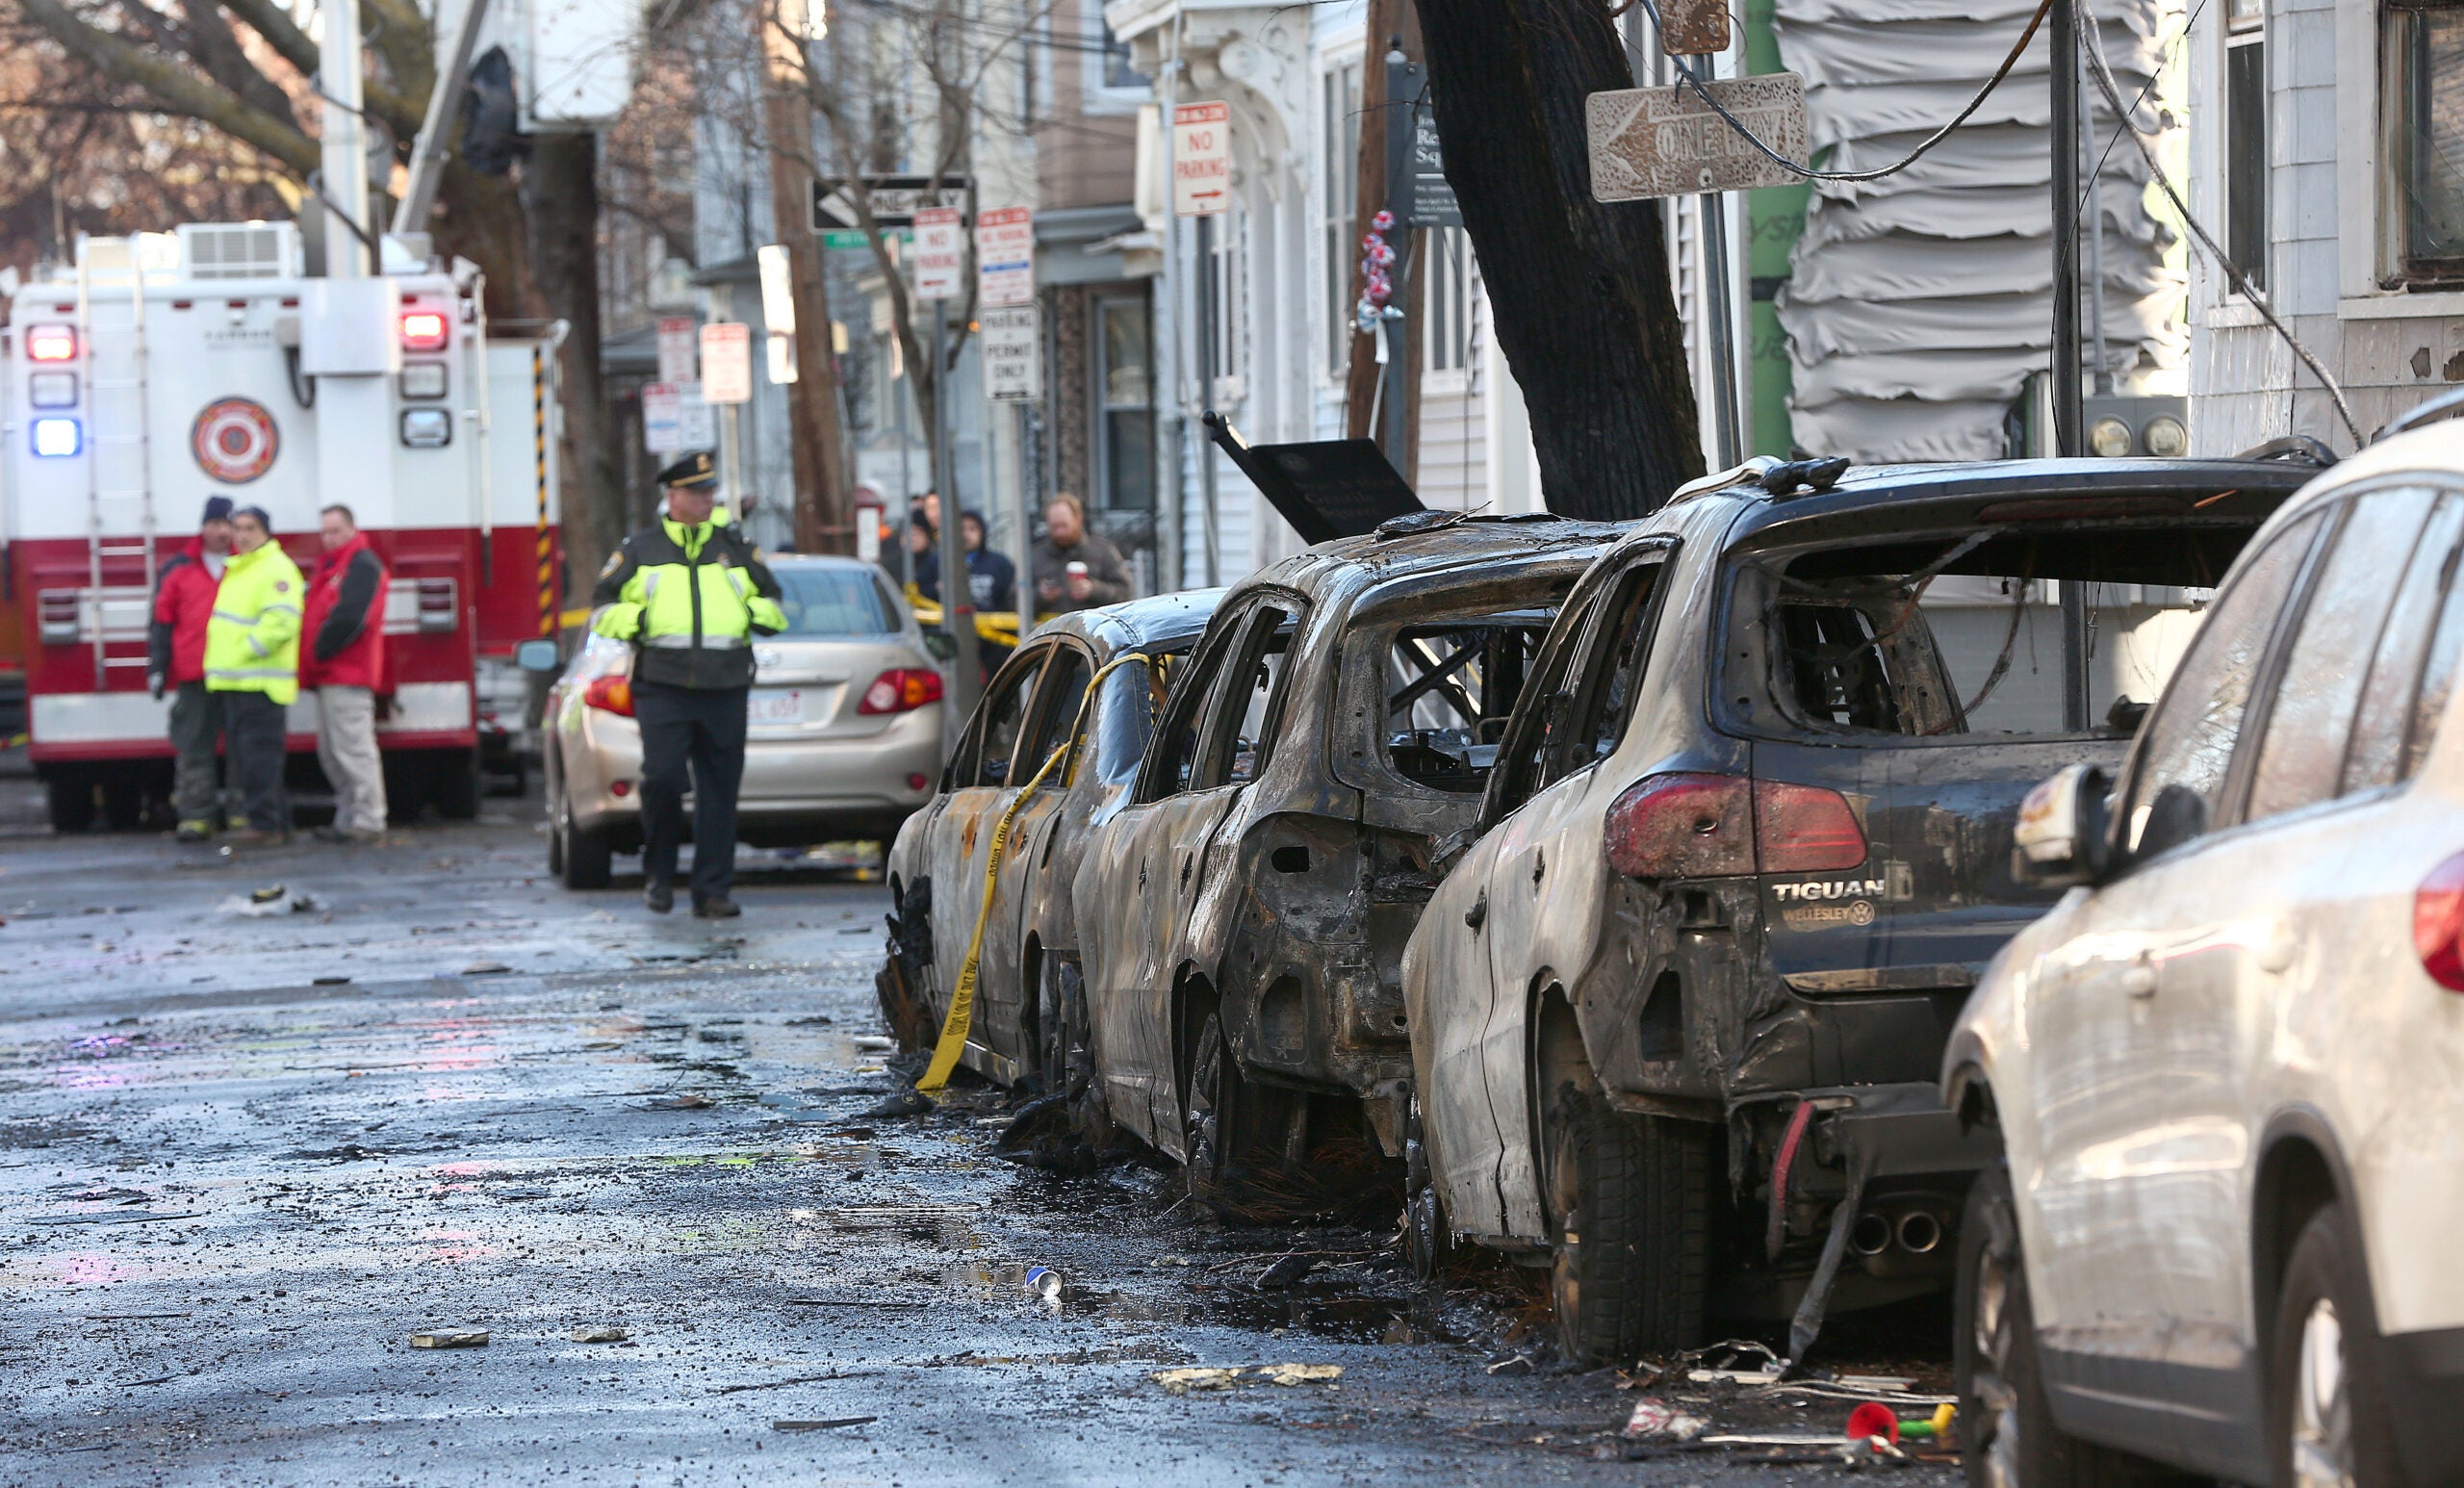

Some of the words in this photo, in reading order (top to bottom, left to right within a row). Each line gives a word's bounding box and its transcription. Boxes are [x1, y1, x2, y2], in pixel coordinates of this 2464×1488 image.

[1188, 130, 1213, 152] NO
[1656, 116, 1722, 163] ONE
[1175, 156, 1225, 181] PARKING
[927, 230, 948, 247] NO
[918, 253, 959, 269] PARKING
[986, 312, 1033, 329] PARKING
[988, 342, 1032, 360] PERMIT
[993, 362, 1025, 380] ONLY
[1771, 879, 1885, 902] TIGUAN
[1783, 906, 1851, 922] WELLESLEY
